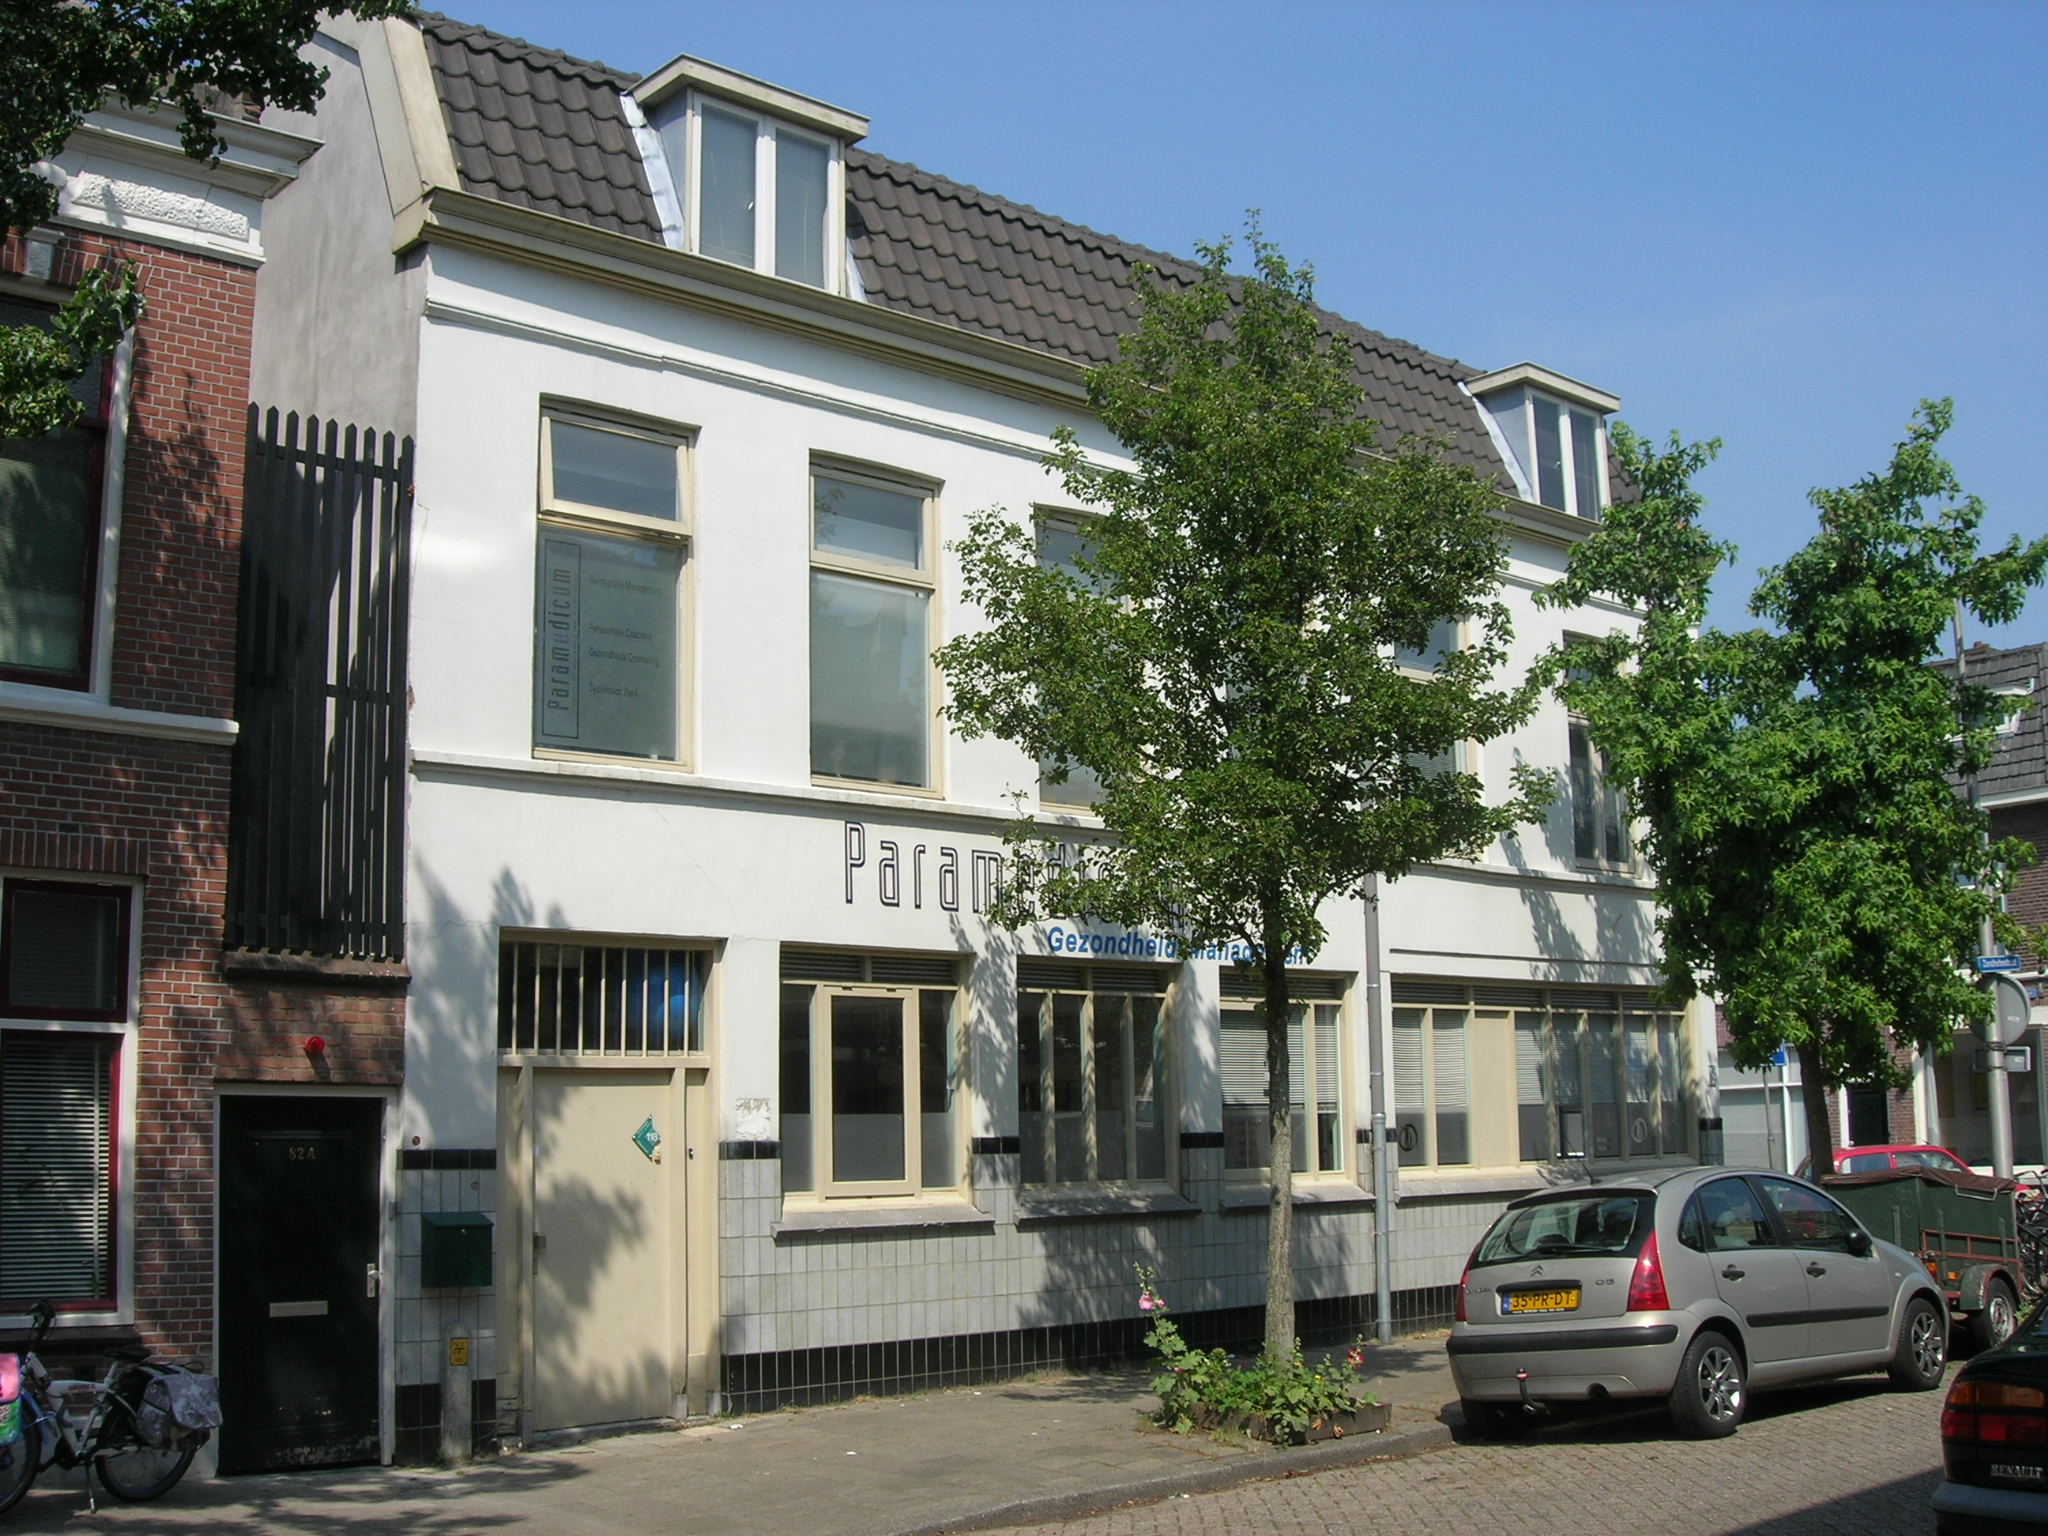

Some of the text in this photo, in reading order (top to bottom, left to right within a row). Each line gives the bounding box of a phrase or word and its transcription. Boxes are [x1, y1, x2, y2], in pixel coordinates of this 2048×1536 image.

[547, 568, 571, 710] Paramedicum
[845, 821, 1185, 928] Paramedi
[1047, 926, 1184, 960] Gezondheid
[1990, 1464, 2044, 1479] RENAULT
